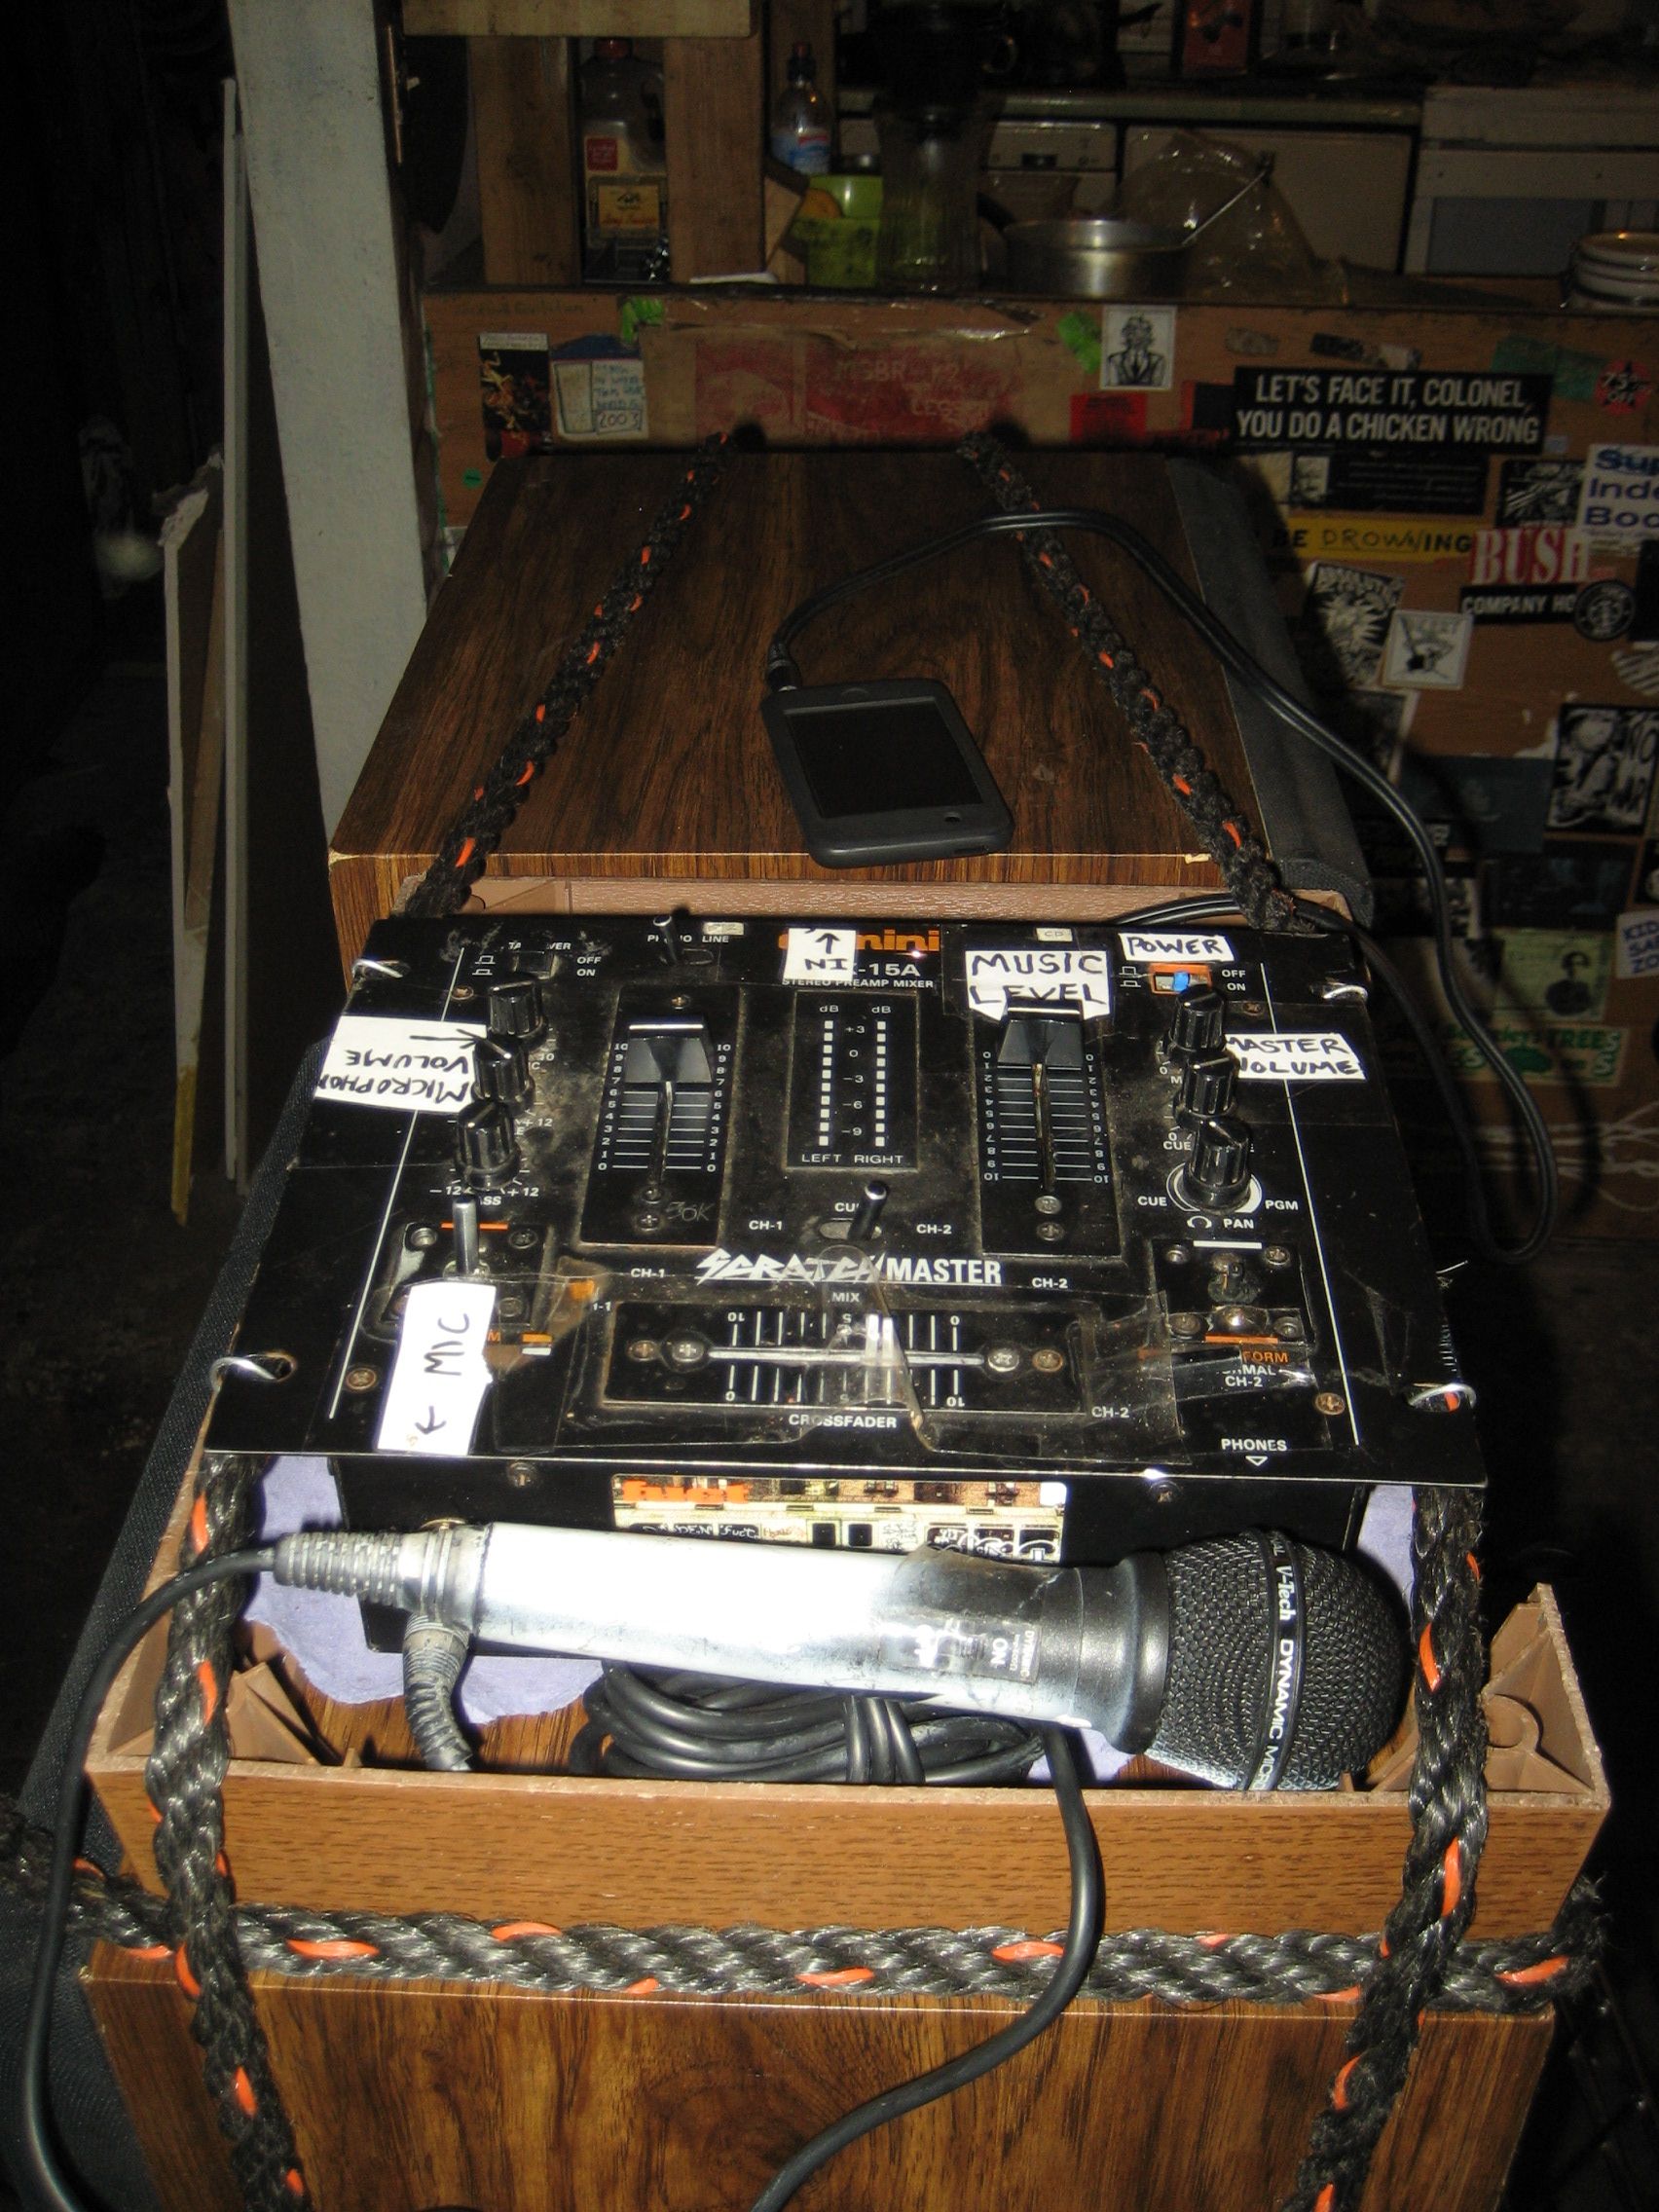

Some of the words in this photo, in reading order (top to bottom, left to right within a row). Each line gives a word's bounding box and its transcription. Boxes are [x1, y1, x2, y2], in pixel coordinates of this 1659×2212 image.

[1255, 374, 1321, 404] LET'S
[1326, 376, 1385, 405] FACE
[1389, 377, 1418, 410] IT,
[1236, 410, 1284, 439] YOU
[1288, 411, 1322, 439] DO
[1325, 412, 1343, 439] A
[1346, 413, 1448, 441] CHICKEN
[1452, 416, 1540, 444] WRONG
[1472, 529, 1589, 585] BUSH
[1461, 595, 1546, 615] COMPANY
[1126, 936, 1225, 956] POWER
[576, 956, 602, 965] OFF
[972, 952, 1106, 976] MUSIC
[1222, 969, 1245, 978] OFF
[893, 979, 934, 988] MIXER
[1227, 982, 1245, 991] ON
[845, 1025, 866, 1034] +3
[849, 1049, 859, 1058] 0
[345, 1048, 469, 1074] VOLUME
[1159, 1066, 1168, 1075] 0
[842, 1075, 865, 1084] -3
[842, 1100, 863, 1110] -6
[841, 1126, 863, 1136] -9
[1168, 1131, 1178, 1141] 0
[1162, 1140, 1192, 1151] CUE
[801, 1154, 842, 1163] LEFT
[854, 1154, 903, 1164] RIGHT
[834, 1201, 861, 1213] CU
[1137, 1196, 1168, 1207] CUE
[1265, 1199, 1299, 1210] PGM
[749, 1220, 783, 1231] CH-1
[916, 1223, 952, 1235] CH-2
[1223, 1218, 1254, 1230] PAN
[630, 1268, 666, 1278] CH-1
[886, 1257, 1002, 1284] MASTER
[1031, 1277, 1069, 1289] CH-2
[831, 1292, 861, 1303] MIX
[949, 1315, 960, 1326] 0
[424, 1313, 470, 1376] MIC
[1225, 1376, 1264, 1387] CH-2
[725, 1390, 736, 1402] 0
[1091, 1406, 1130, 1419] CH-2
[789, 1413, 898, 1429] CROSSFADER
[1221, 1438, 1288, 1452] PHONES
[1275, 1565, 1297, 1621] V-Tech
[991, 1638, 1009, 1669] ON
[1268, 1639, 1295, 1740] DYNAMIC
